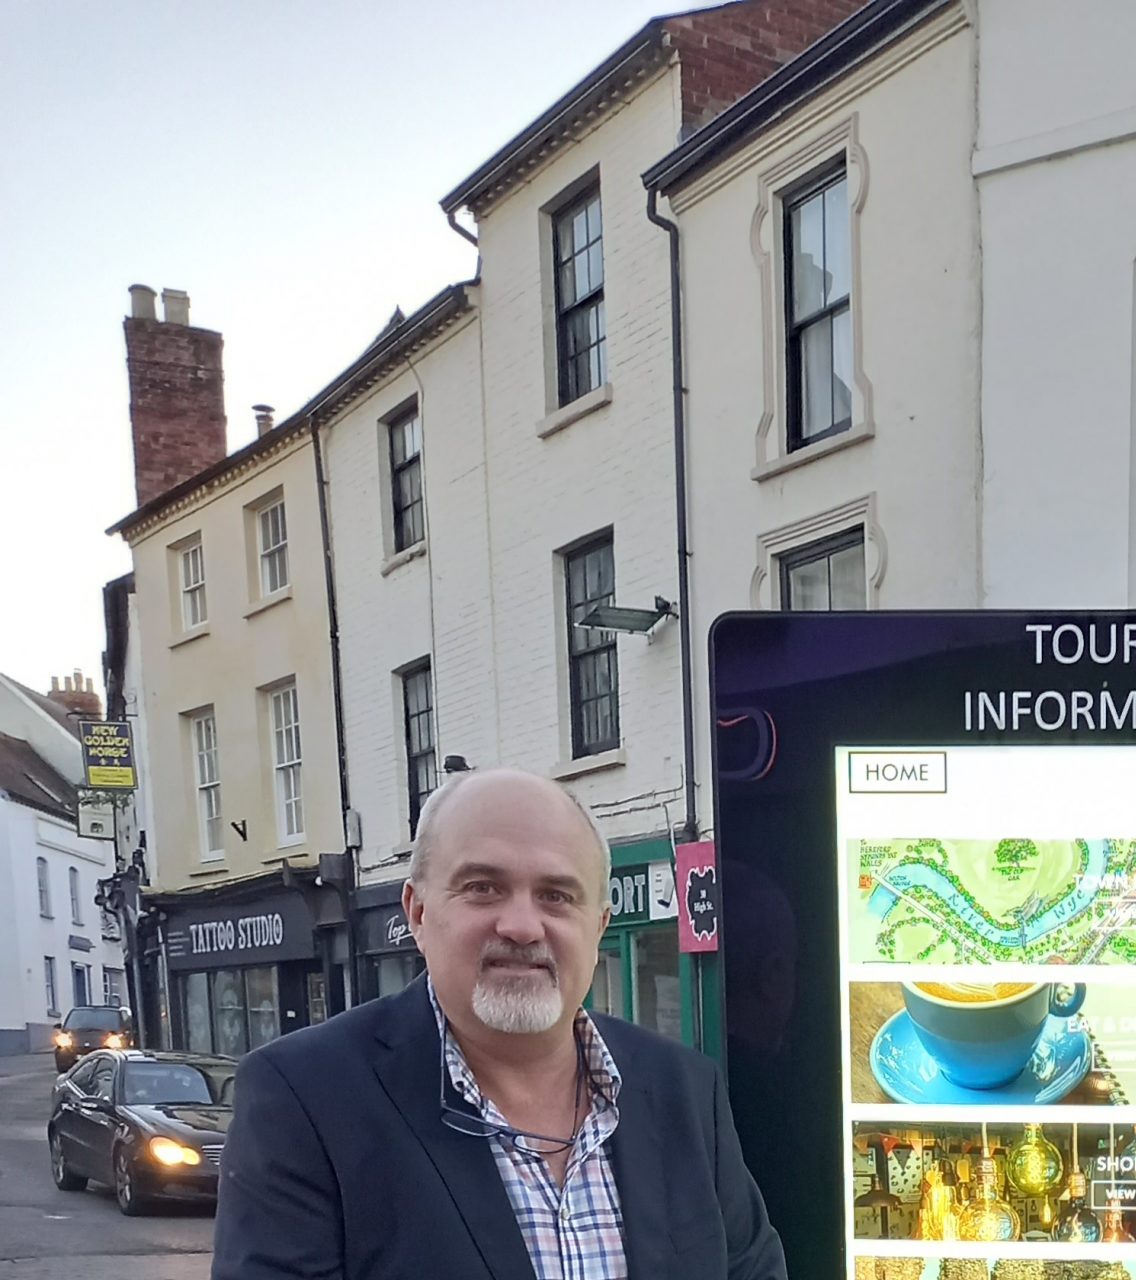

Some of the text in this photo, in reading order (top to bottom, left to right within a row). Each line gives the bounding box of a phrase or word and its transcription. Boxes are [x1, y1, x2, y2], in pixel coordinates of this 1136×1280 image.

[865, 763, 929, 782] HOME
[189, 913, 283, 953] TATTOO STUDIO
[385, 914, 407, 945] Top
[1105, 1188, 1136, 1200] VIEW
